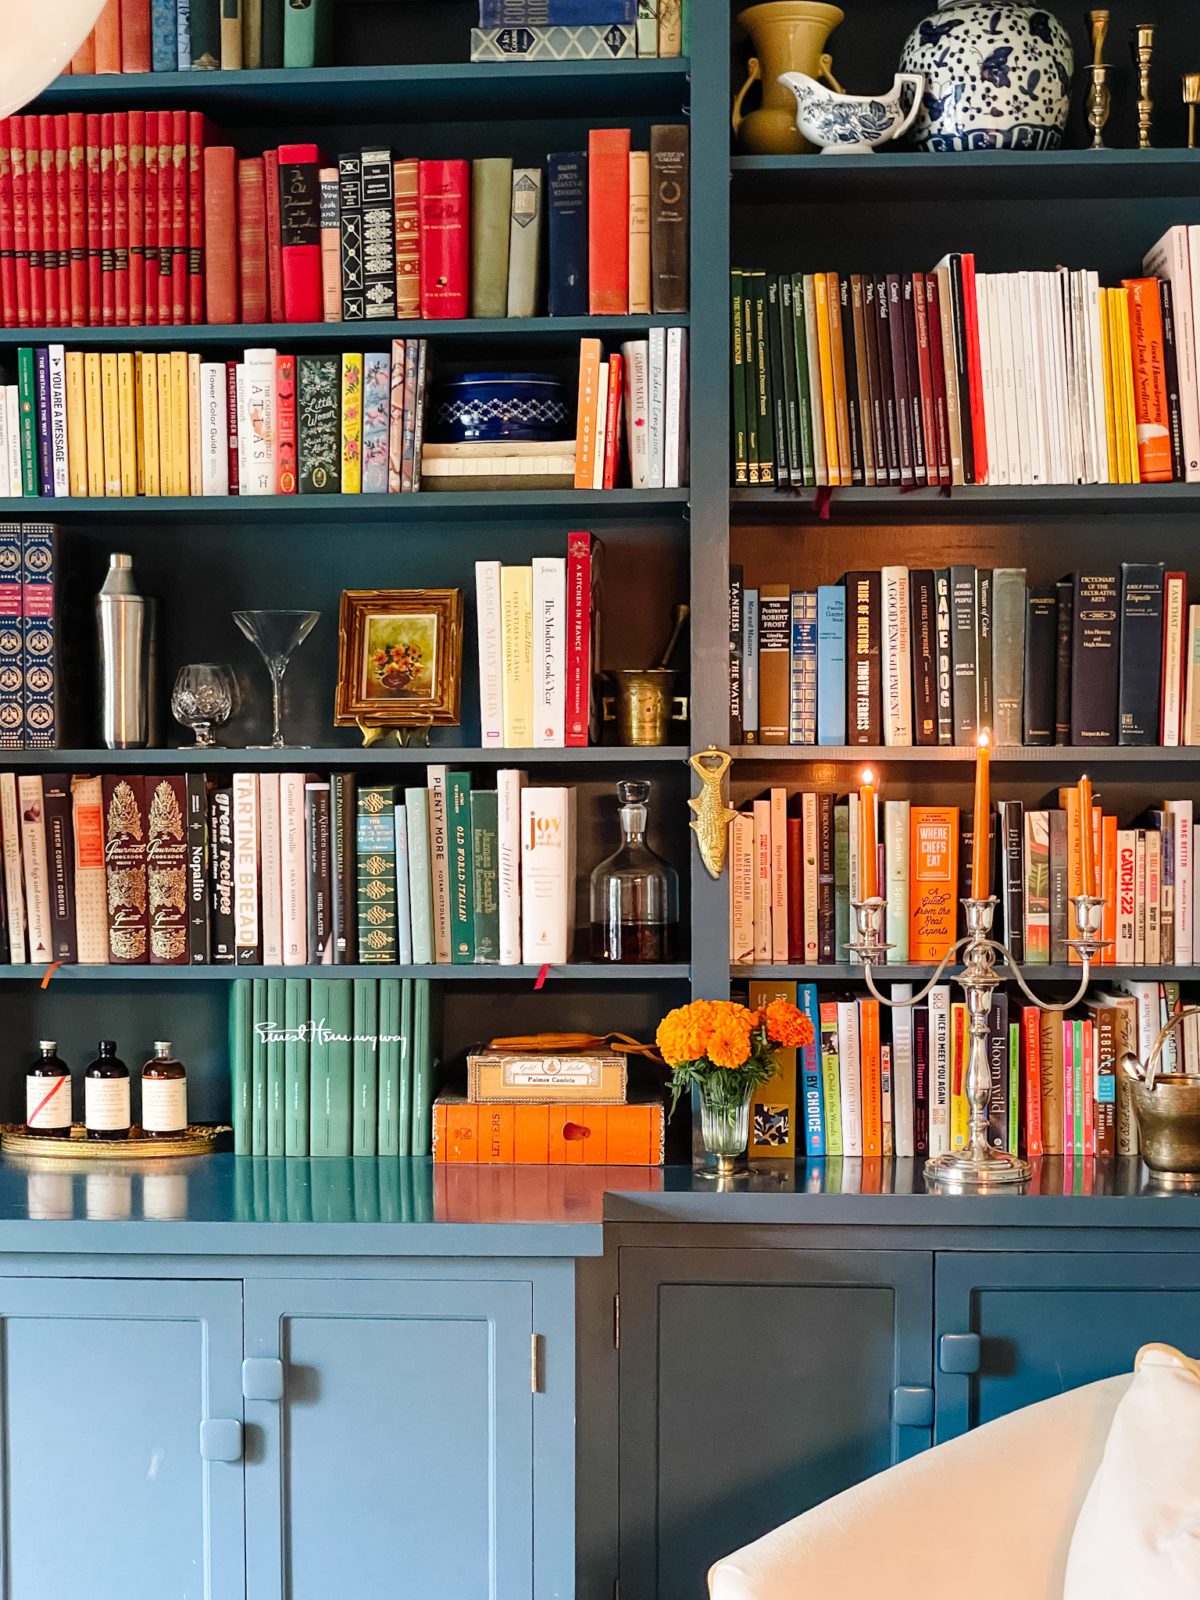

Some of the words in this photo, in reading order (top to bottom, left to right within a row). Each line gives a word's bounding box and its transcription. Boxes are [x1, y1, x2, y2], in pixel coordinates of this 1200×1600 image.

[891, 282, 899, 302] Candy
[1133, 284, 1142, 302] New
[1134, 304, 1146, 342] Complete
[734, 328, 742, 364] GARDENER
[1138, 344, 1146, 365] Book
[1151, 341, 1159, 364] Good
[53, 372, 62, 390] YOU
[1138, 367, 1148, 375] of
[53, 391, 62, 410] ARE
[305, 398, 334, 413] Little
[1140, 378, 1150, 424] Needlecraft
[1150, 366, 1162, 423] Housekeeping
[253, 386, 264, 458] ATLAS
[301, 412, 337, 426] Women
[54, 420, 64, 461] MESSAGE
[485, 568, 494, 619] CLASSIC
[858, 580, 869, 602] TRIBE
[888, 579, 896, 587] A
[1171, 590, 1178, 604] AM
[544, 600, 554, 615] The
[576, 610, 582, 618] IN
[858, 605, 869, 614] OF
[889, 588, 897, 621] GOOD
[980, 608, 989, 617] of
[486, 628, 496, 667] MARY
[545, 618, 554, 653] Modern
[858, 617, 869, 654] MENTORS
[889, 624, 898, 671] ENOUGH
[545, 655, 554, 684] Cook's
[858, 661, 869, 696] TIMOTHY
[487, 674, 498, 719] BERRY
[545, 686, 554, 705] Year
[732, 681, 740, 716] WATER
[890, 674, 900, 720] PARENT
[858, 698, 869, 730] FERRISS
[287, 783, 295, 816] Cannelle
[434, 778, 442, 822] PLENTY
[53, 821, 61, 847] FRENCH
[215, 794, 232, 845] great
[238, 775, 254, 864] TARTINE
[320, 815, 328, 848] Kitchen
[456, 826, 465, 844] OLD
[525, 811, 560, 850] joy
[920, 828, 948, 839] WHERE
[28, 834, 38, 856] platter
[288, 828, 296, 854] Vanille
[436, 828, 444, 860] MORE
[922, 841, 946, 853] CHEFS
[30, 867, 40, 879] figs
[55, 850, 63, 882] COUNTRY
[190, 846, 204, 901] Nopalito
[457, 848, 466, 881] WORLD
[501, 843, 513, 898] Jubilee
[926, 855, 940, 866] EAT
[33, 881, 41, 893] and
[216, 850, 233, 914] recipes
[57, 885, 65, 916] COOKING
[239, 873, 255, 942] BREAD
[458, 883, 466, 922] ITALIAN
[914, 908, 936, 917] from
[922, 894, 951, 906] Guide
[33, 915, 42, 938] recipes
[918, 927, 948, 936] Experts
[926, 917, 942, 927] Real
[254, 1022, 309, 1044] Ernest
[309, 1018, 407, 1059] Hemingway
[938, 1033, 944, 1041] TO
[1100, 1025, 1112, 1074] REBECCA
[805, 1040, 817, 1072] REAT
[992, 1037, 1004, 1079] bloom
[1041, 1026, 1053, 1097] WHITMAN
[807, 1076, 817, 1088] BY
[807, 1092, 820, 1132] CHOICE
[991, 1084, 1005, 1113] wild
